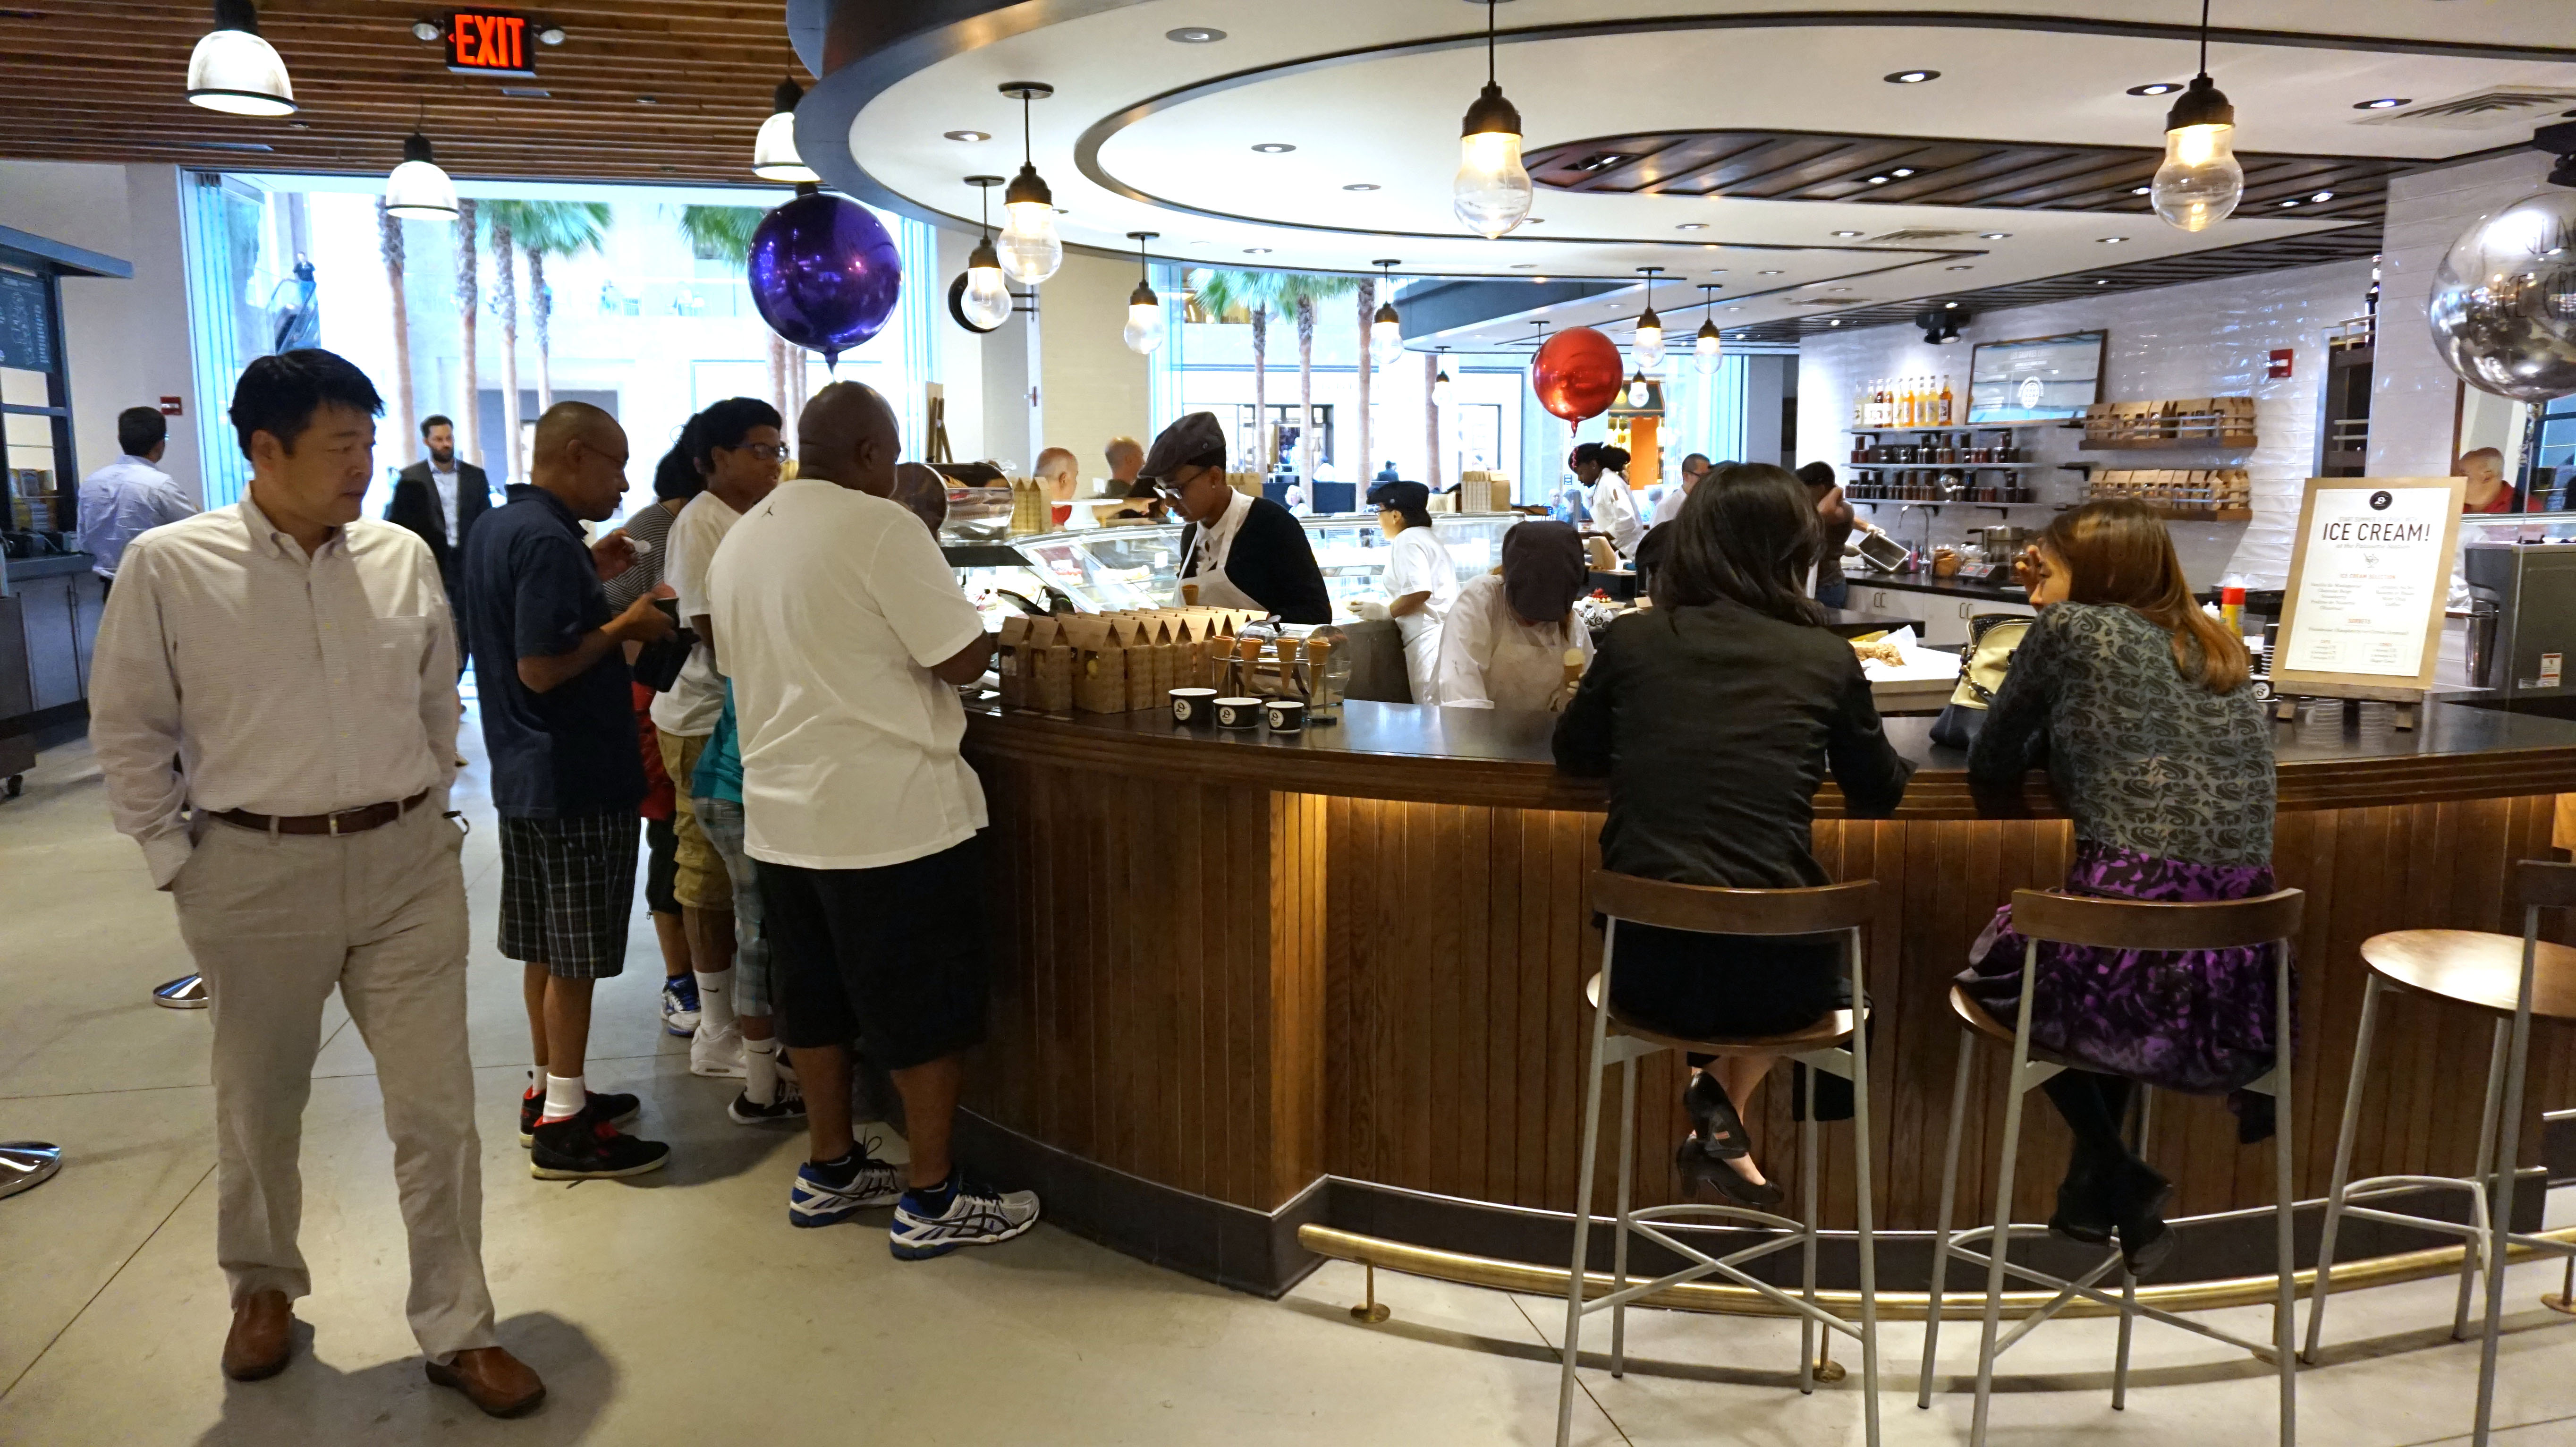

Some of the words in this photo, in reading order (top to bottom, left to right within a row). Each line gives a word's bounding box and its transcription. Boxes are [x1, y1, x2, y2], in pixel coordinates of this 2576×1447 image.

[455, 14, 525, 68] EXIT
[2322, 523, 2352, 540] ICE
[2357, 523, 2430, 541] CREAM!
